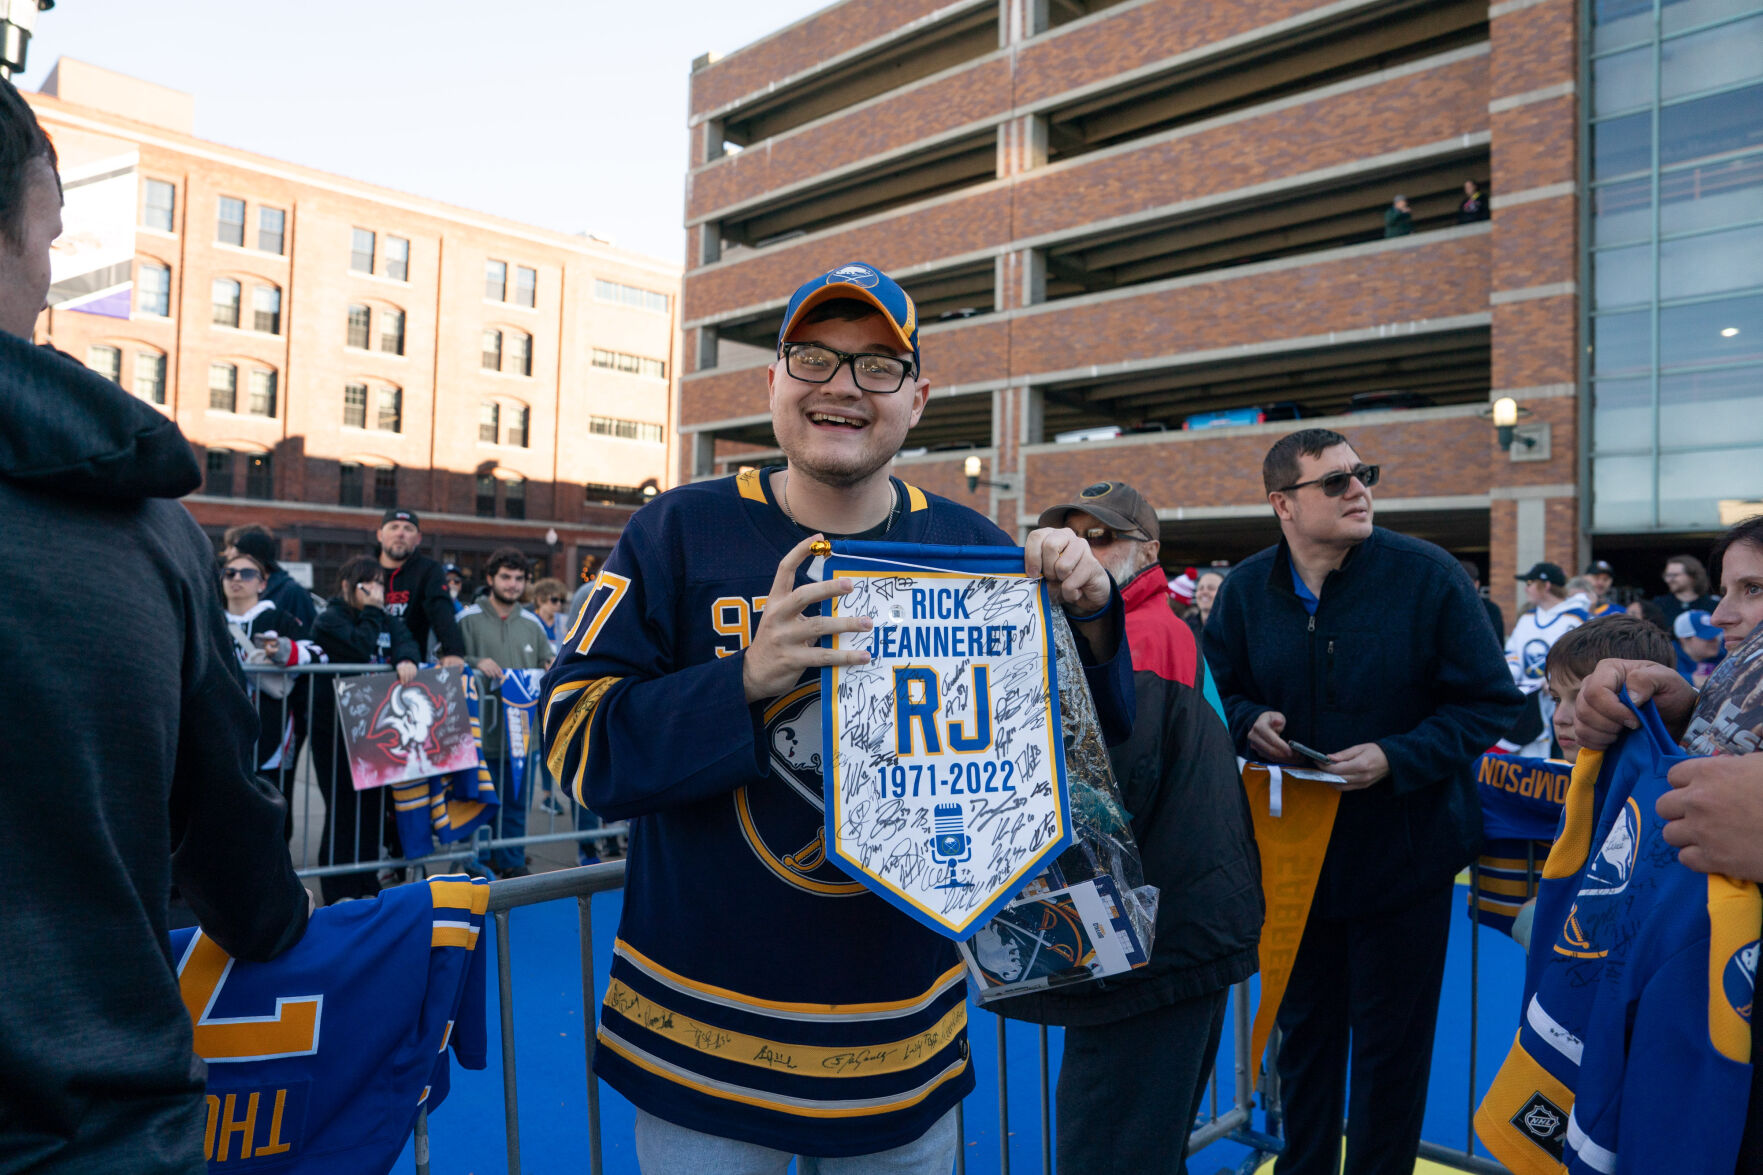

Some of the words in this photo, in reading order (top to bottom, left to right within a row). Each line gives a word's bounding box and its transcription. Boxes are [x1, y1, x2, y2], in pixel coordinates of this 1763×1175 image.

[911, 588, 970, 620] RICK
[867, 625, 1017, 659] JEANNERET
[892, 663, 993, 758] RJ
[878, 760, 1016, 799] 1971-2022
[1529, 1116, 1553, 1127] NHL
